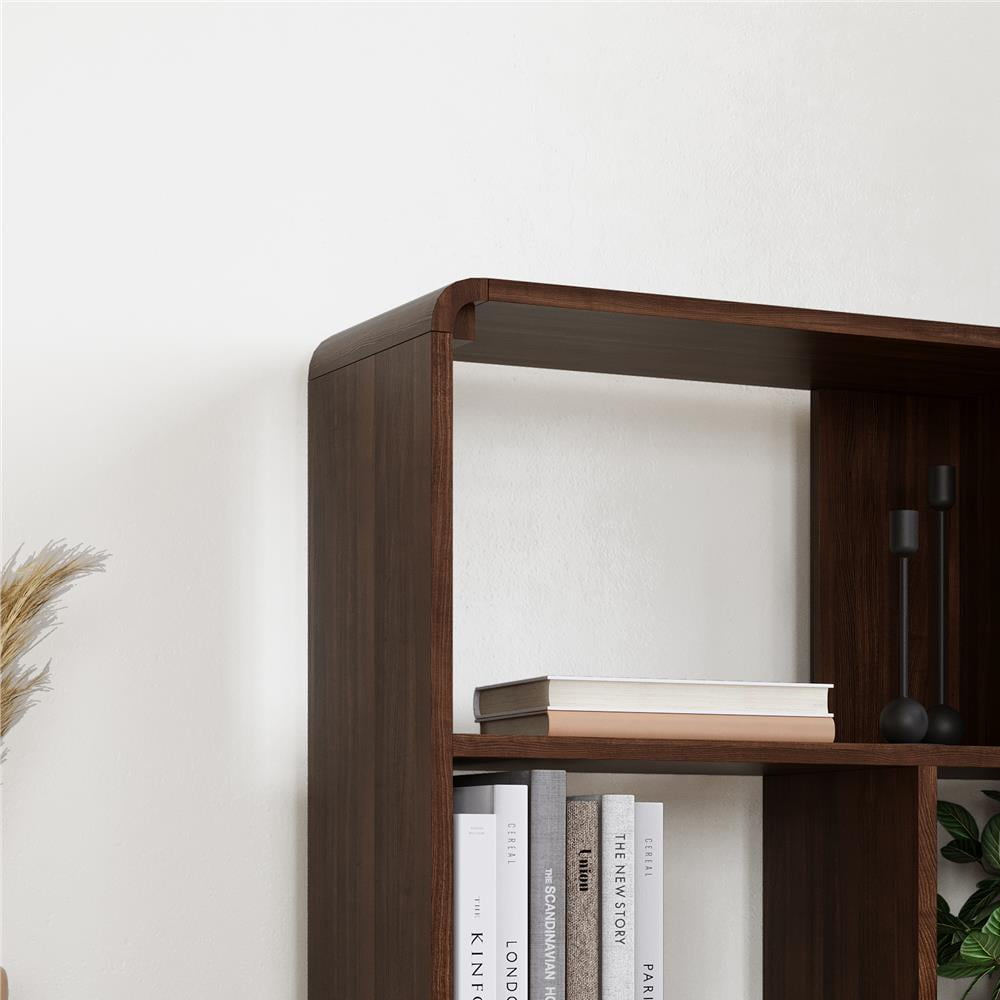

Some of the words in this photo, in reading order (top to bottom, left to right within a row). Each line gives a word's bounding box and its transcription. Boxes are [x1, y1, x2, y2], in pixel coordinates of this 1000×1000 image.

[506, 822, 516, 865] CEREAL
[615, 833, 625, 859] THE
[644, 838, 653, 877] CEREAL
[578, 849, 592, 893] Union
[615, 863, 625, 899] NEW
[473, 897, 481, 919] THE
[614, 901, 626, 946] STORY
[545, 885, 556, 980] SCANDINAVIAN
